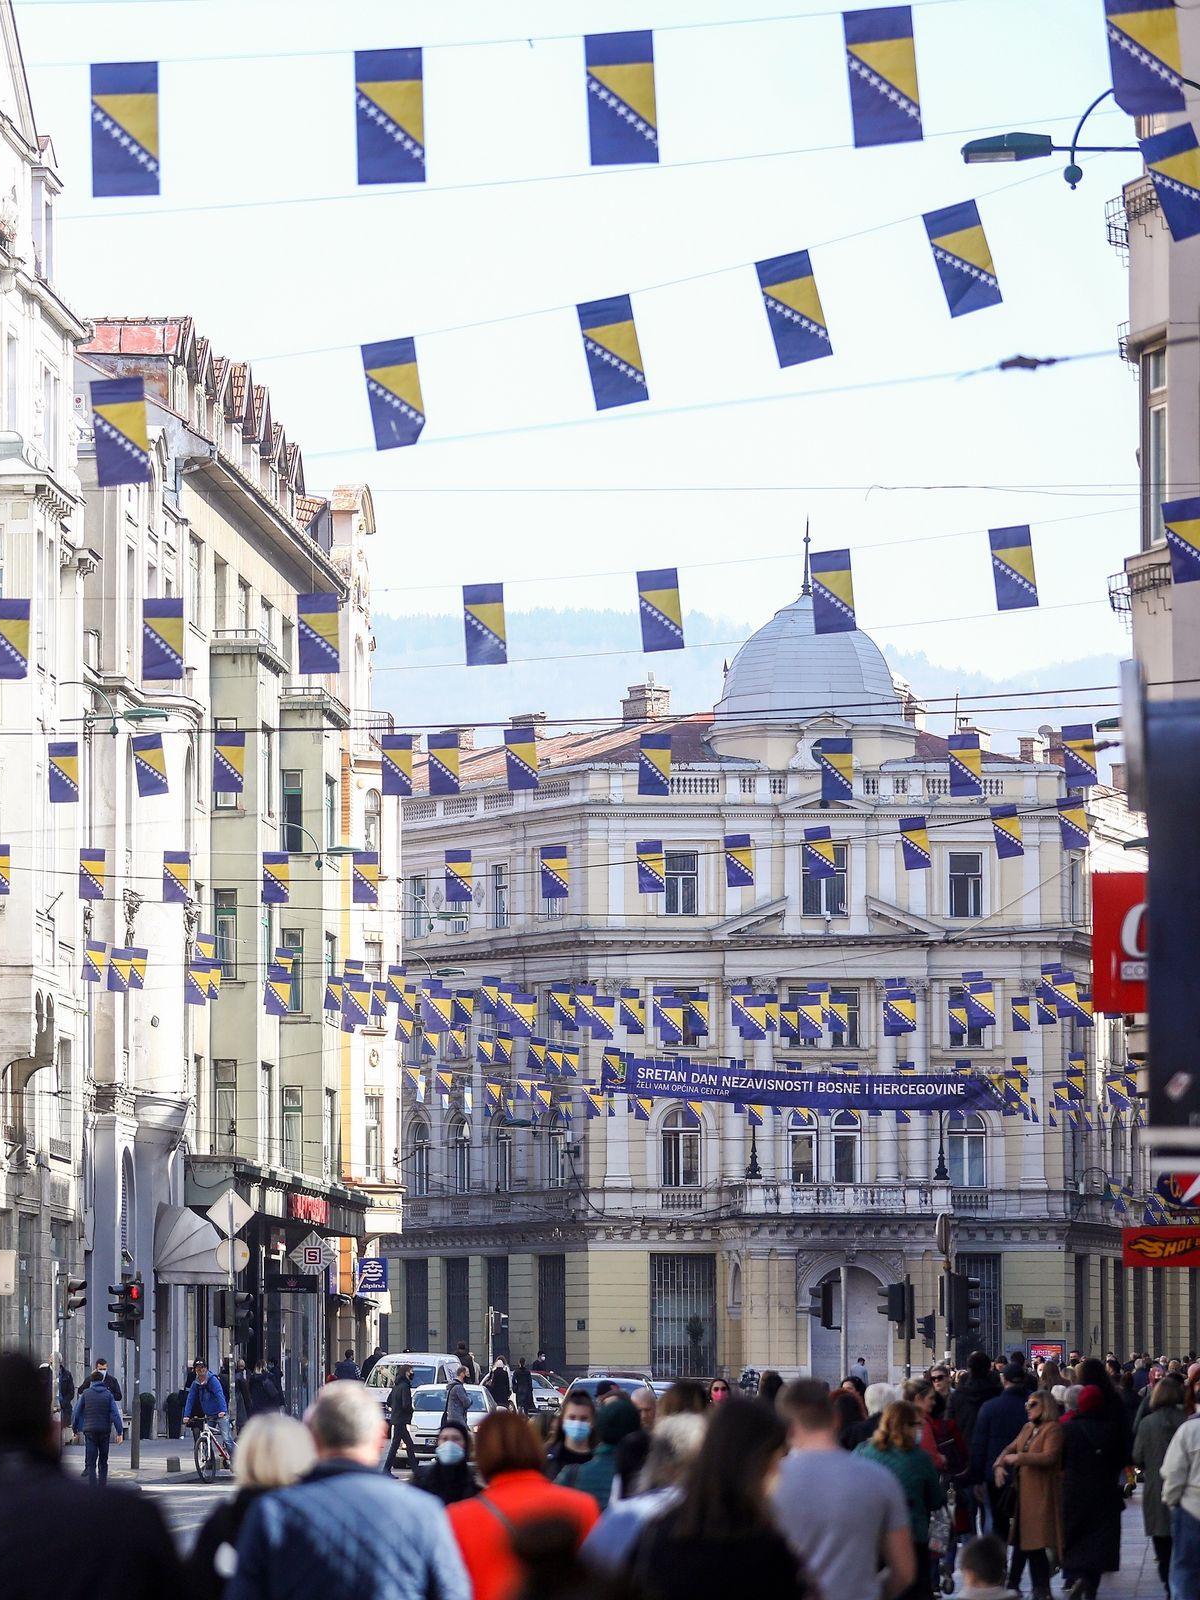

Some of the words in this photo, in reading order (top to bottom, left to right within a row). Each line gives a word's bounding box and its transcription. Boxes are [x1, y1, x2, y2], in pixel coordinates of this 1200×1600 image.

[637, 1067, 686, 1083] SRETAN
[691, 1072, 717, 1086] DAN
[722, 1075, 813, 1092] NEZAVISNOSTI
[817, 1081, 861, 1095] BOSNE
[873, 1083, 965, 1095] HERCEGOVINE
[653, 1083, 670, 1091] VAM
[700, 1086, 730, 1097] CENTAR
